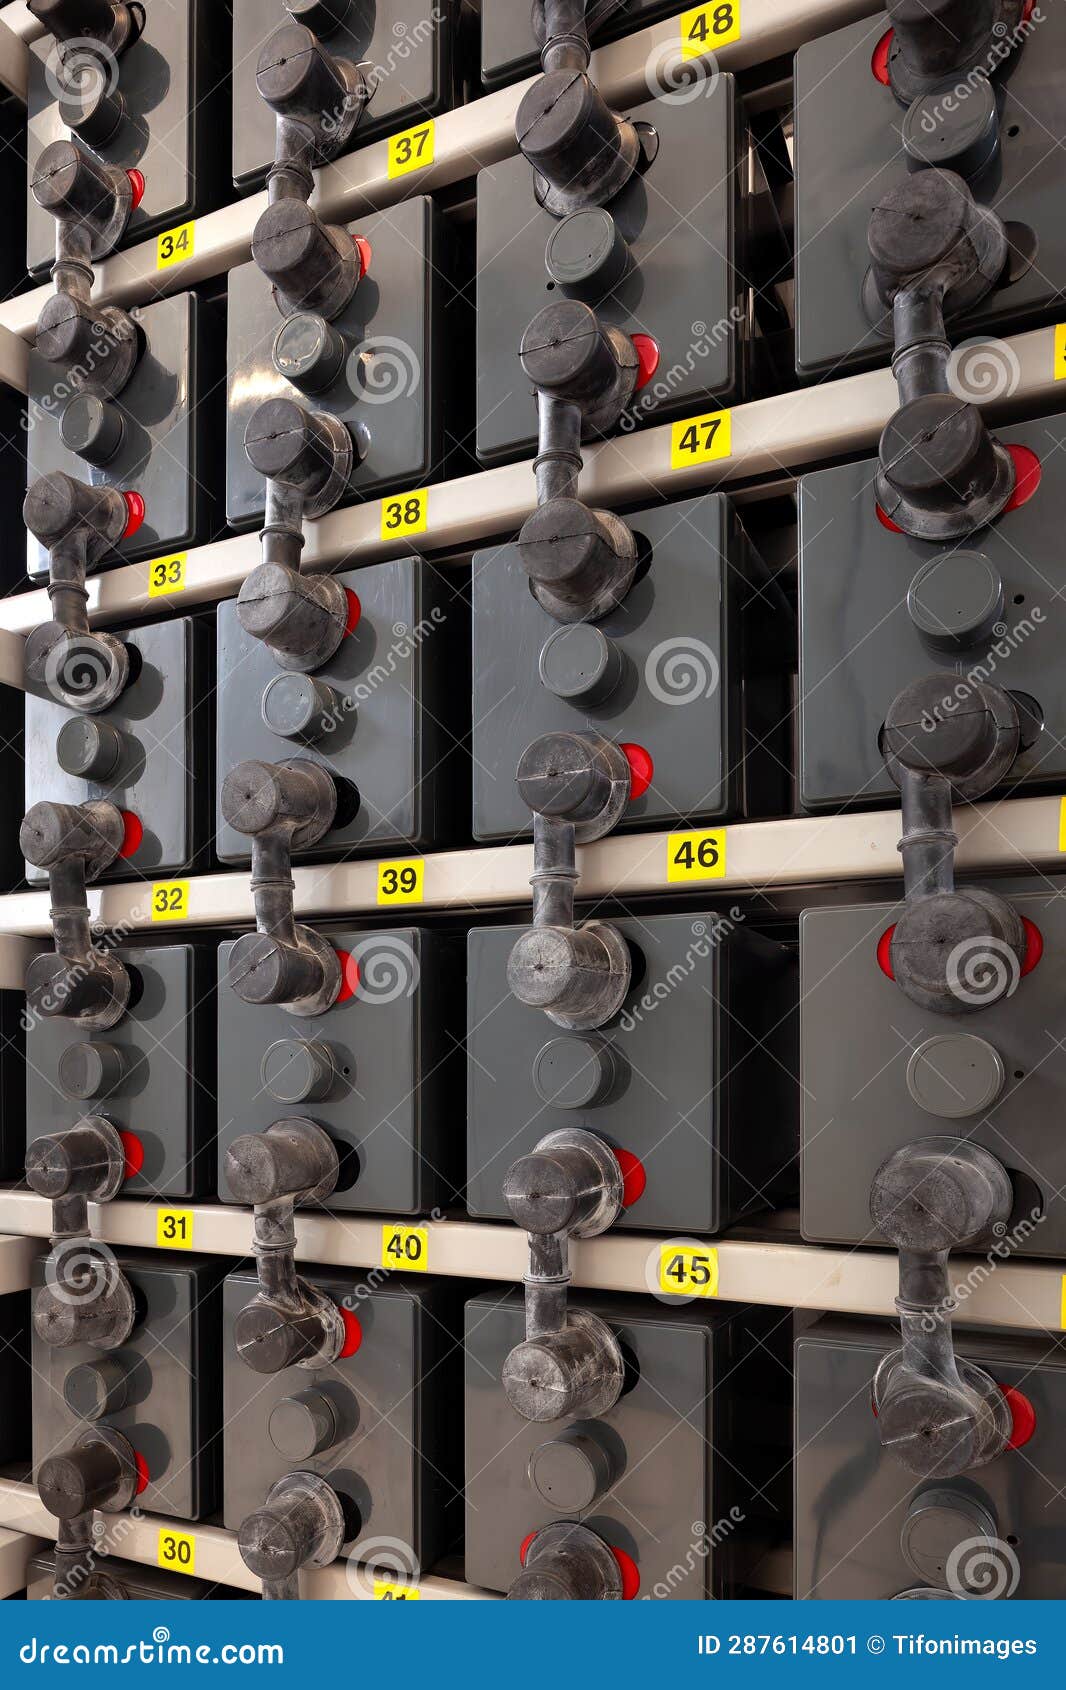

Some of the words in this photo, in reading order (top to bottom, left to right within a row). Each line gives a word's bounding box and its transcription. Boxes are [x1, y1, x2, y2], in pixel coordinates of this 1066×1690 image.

[687, 4, 734, 42] 48
[395, 129, 431, 165] 37
[160, 229, 189, 260] 34
[678, 418, 722, 454] 47
[385, 498, 421, 530] 38
[153, 560, 182, 588] 33
[673, 838, 719, 870] 46
[382, 867, 418, 895] 39
[154, 887, 183, 913] 32
[162, 1215, 187, 1240] 31
[386, 1233, 422, 1261] 40
[665, 1254, 711, 1286] 45
[162, 1536, 191, 1564] 30
